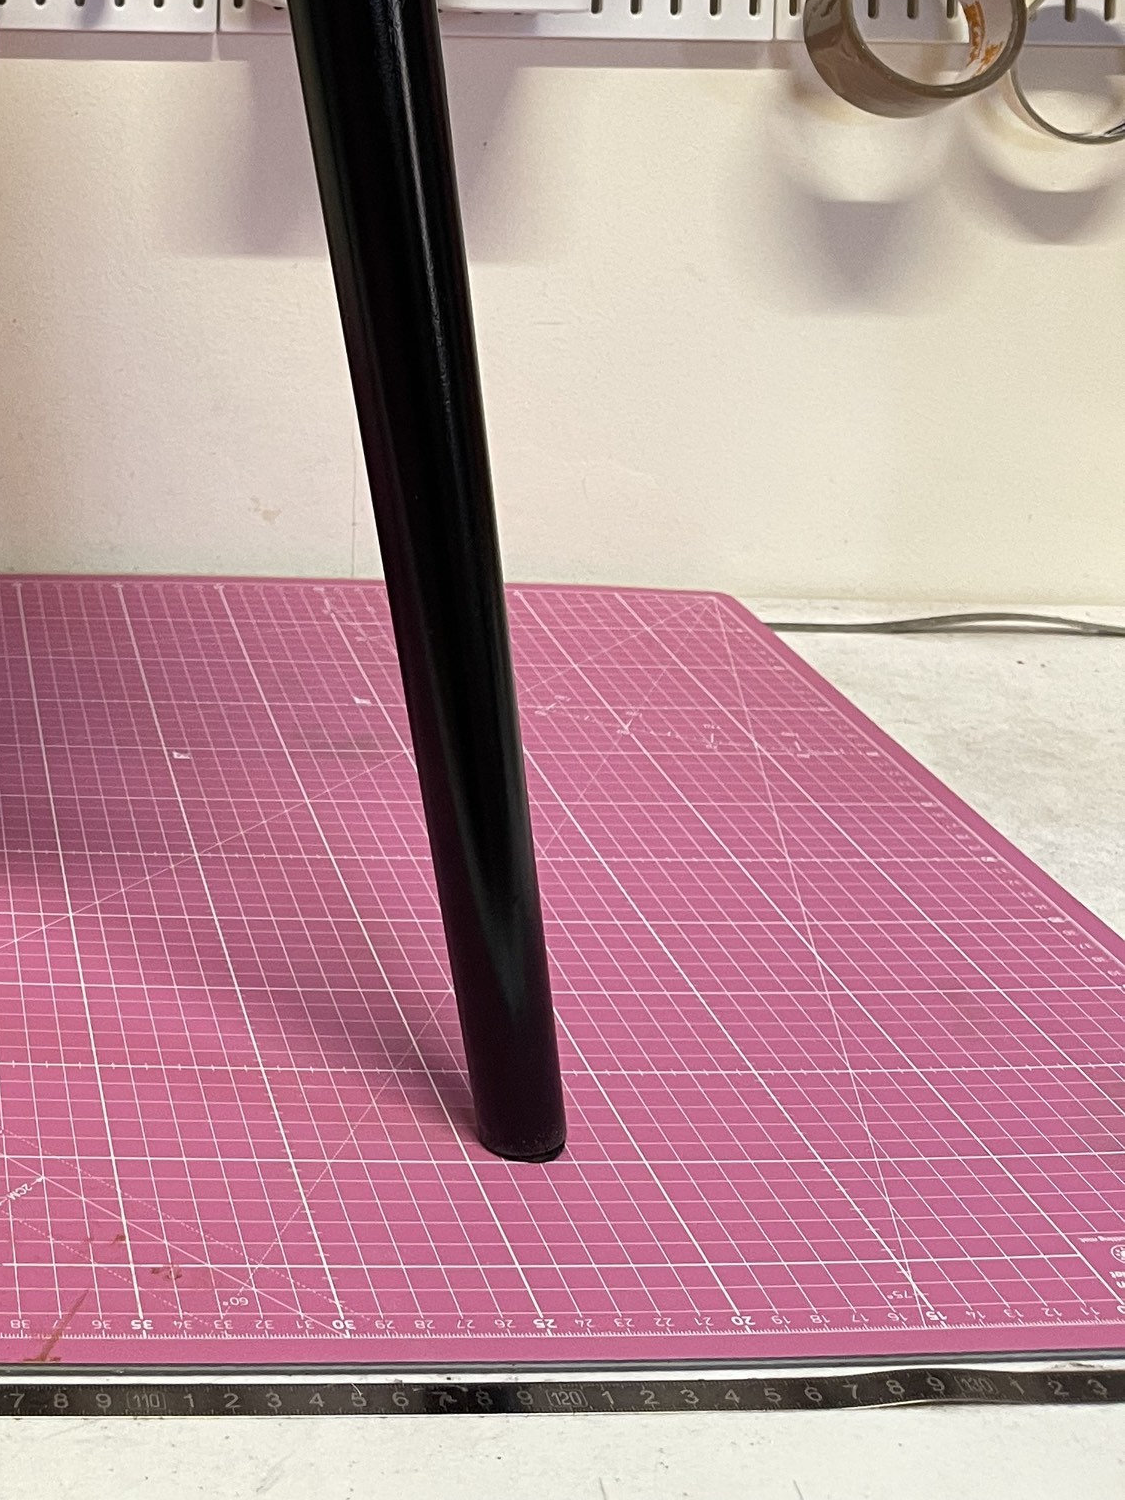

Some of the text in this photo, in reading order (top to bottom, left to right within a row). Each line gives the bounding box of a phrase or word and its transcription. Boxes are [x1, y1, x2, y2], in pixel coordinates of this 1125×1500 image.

[6, 1184, 33, 1200] 2CM
[930, 1310, 947, 1322] 15
[966, 1310, 986, 1320] 14
[1005, 1309, 1024, 1319] 13
[1041, 1307, 1062, 1317] 12
[1080, 1306, 1100, 1316] 11
[656, 1317, 673, 1327] 22
[694, 1316, 714, 1327] 21
[731, 1314, 755, 1326] 20
[772, 1314, 790, 1324] 19
[810, 1314, 830, 1324] 18
[852, 1313, 868, 1323] 17
[888, 1312, 907, 1323] 16
[11, 1319, 30, 1329] 38
[92, 1320, 111, 1330] 36
[131, 1319, 153, 1330] 35
[173, 1319, 193, 1330] 34
[214, 1319, 233, 1329] 33
[256, 1319, 274, 1329] 32
[295, 1319, 315, 1329] 31
[333, 1319, 355, 1330] 30
[375, 1319, 395, 1330] 29
[415, 1319, 435, 1330] 28
[457, 1319, 474, 1330] 27
[496, 1319, 516, 1329] 26
[533, 1318, 556, 1329] 25
[575, 1318, 595, 1328] 24
[615, 1318, 634, 1328] 23
[10, 1393, 25, 1408] 7
[53, 1393, 69, 1408] 8
[96, 1393, 111, 1408] 9
[133, 1394, 158, 1408] 110
[185, 1394, 194, 1408] 1
[224, 1394, 241, 1407] 2
[266, 1393, 282, 1408] 3
[309, 1393, 324, 1407] 4
[352, 1393, 367, 1407] 5
[393, 1392, 409, 1406] 6
[475, 1392, 490, 1406] 8
[518, 1391, 534, 1405] 9
[551, 1391, 578, 1406] 120
[602, 1390, 613, 1404] 1
[639, 1390, 657, 1405] 2
[680, 1389, 699, 1404] 3
[725, 1388, 739, 1402] 4
[765, 1387, 780, 1401] 5
[804, 1386, 821, 1401] 6
[844, 1384, 859, 1399] 7
[886, 1380, 905, 1395] 8
[927, 1377, 944, 1392] 9
[1010, 1380, 1024, 1394] 1
[1048, 1381, 1067, 1395] 2
[1087, 1380, 1106, 1395] 3
